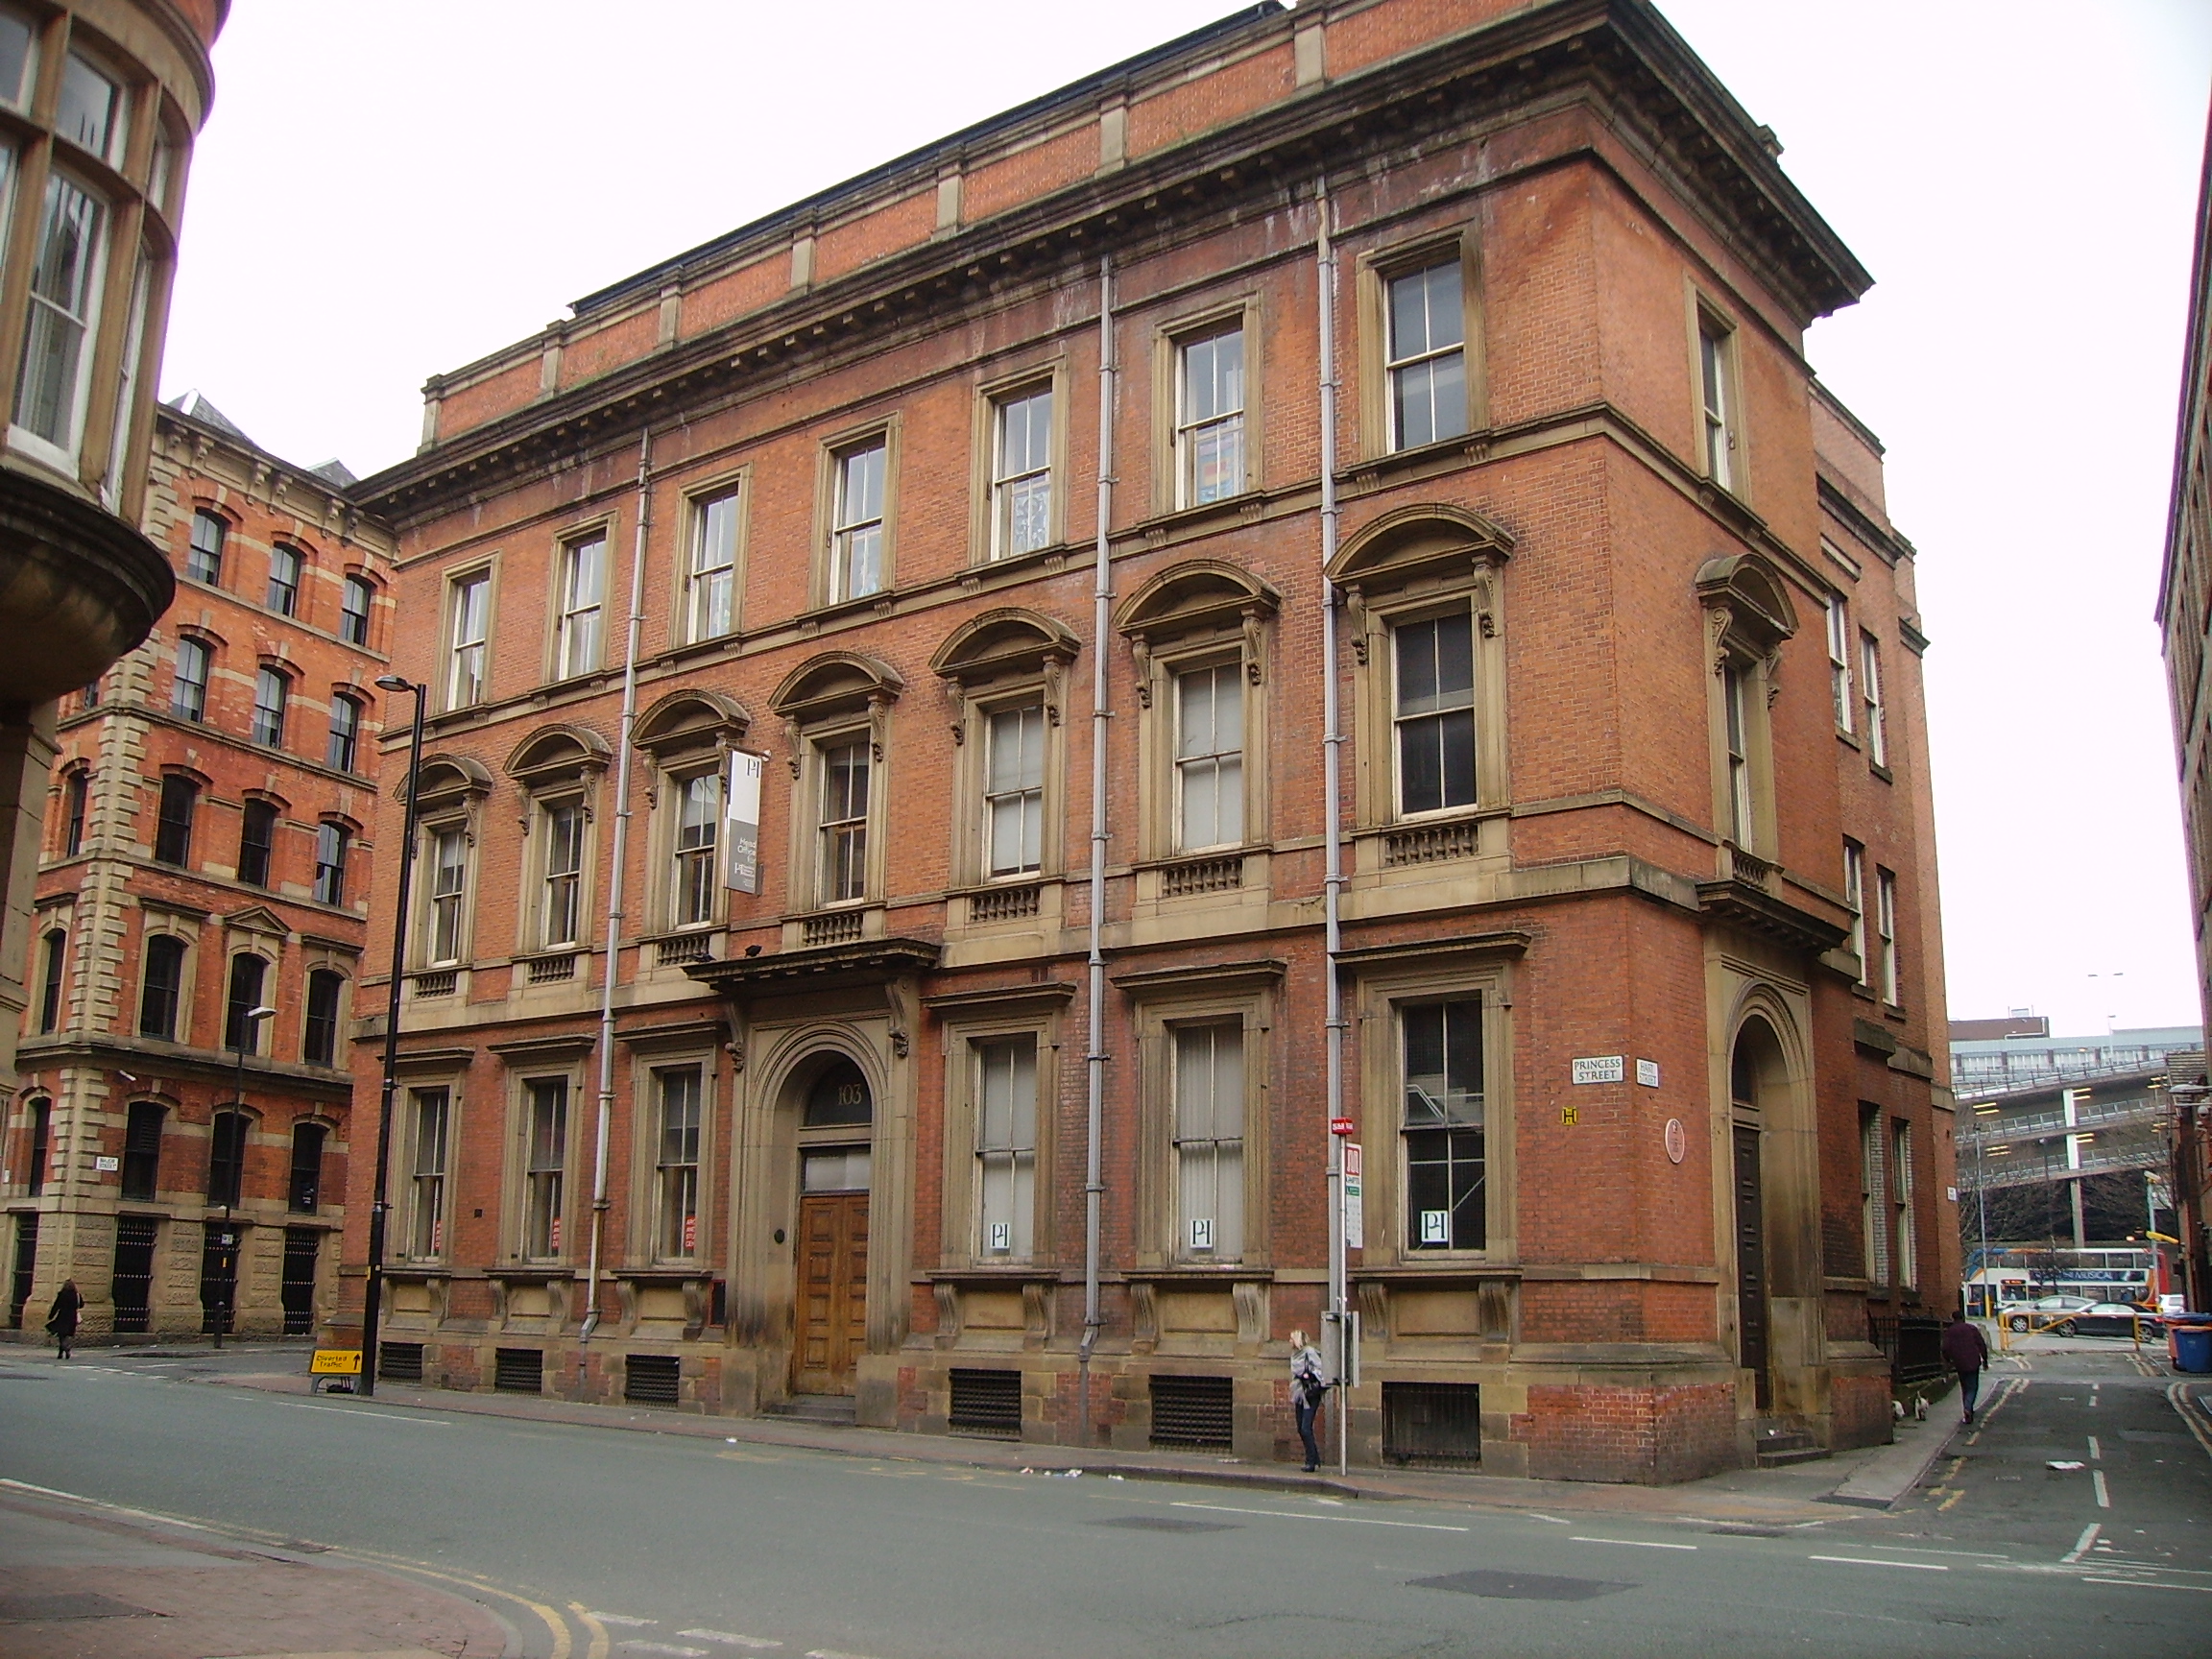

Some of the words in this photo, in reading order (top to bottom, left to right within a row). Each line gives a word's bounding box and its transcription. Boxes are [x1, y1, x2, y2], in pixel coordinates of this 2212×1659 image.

[739, 837, 757, 849] Head
[1575, 1058, 1621, 1070] PRINCESS
[1579, 1070, 1617, 1081] STREET
[1639, 1072, 1657, 1085] STREET
[837, 1084, 862, 1105] 103
[2075, 1270, 2112, 1280] MUSICAL
